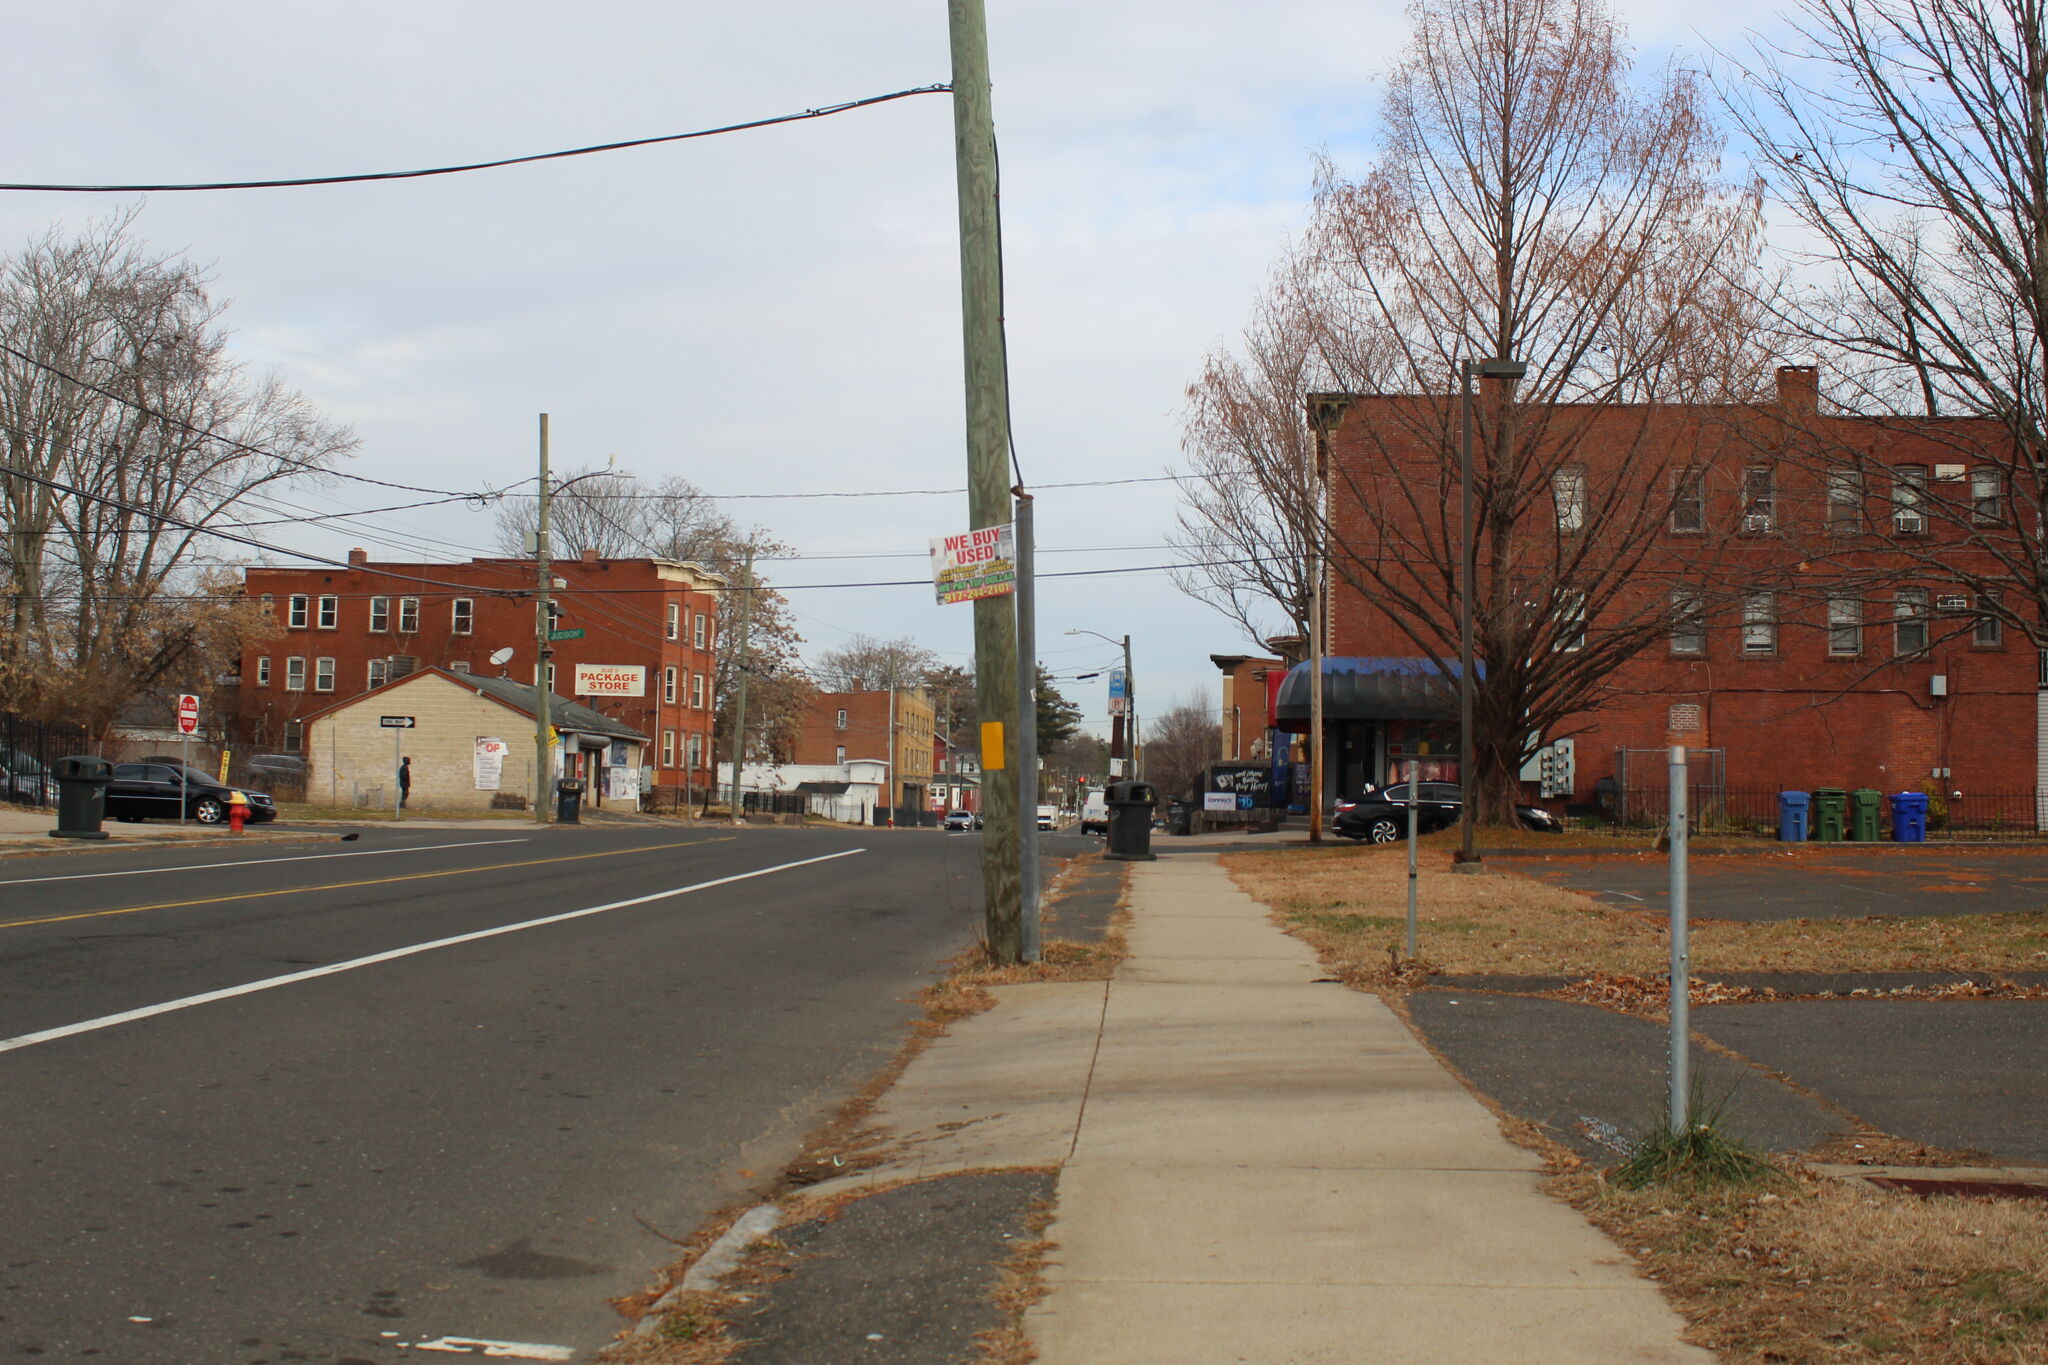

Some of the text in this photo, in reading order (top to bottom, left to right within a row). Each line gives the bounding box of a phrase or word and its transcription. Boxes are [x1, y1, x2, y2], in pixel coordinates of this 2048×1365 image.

[944, 528, 1000, 551] WE BUY
[956, 545, 994, 565] USED
[937, 570, 1016, 594] WE PAY TOP DOLLAR
[550, 631, 579, 640] JUDSON
[581, 672, 638, 682] PACKAGE
[589, 681, 630, 690] STORE
